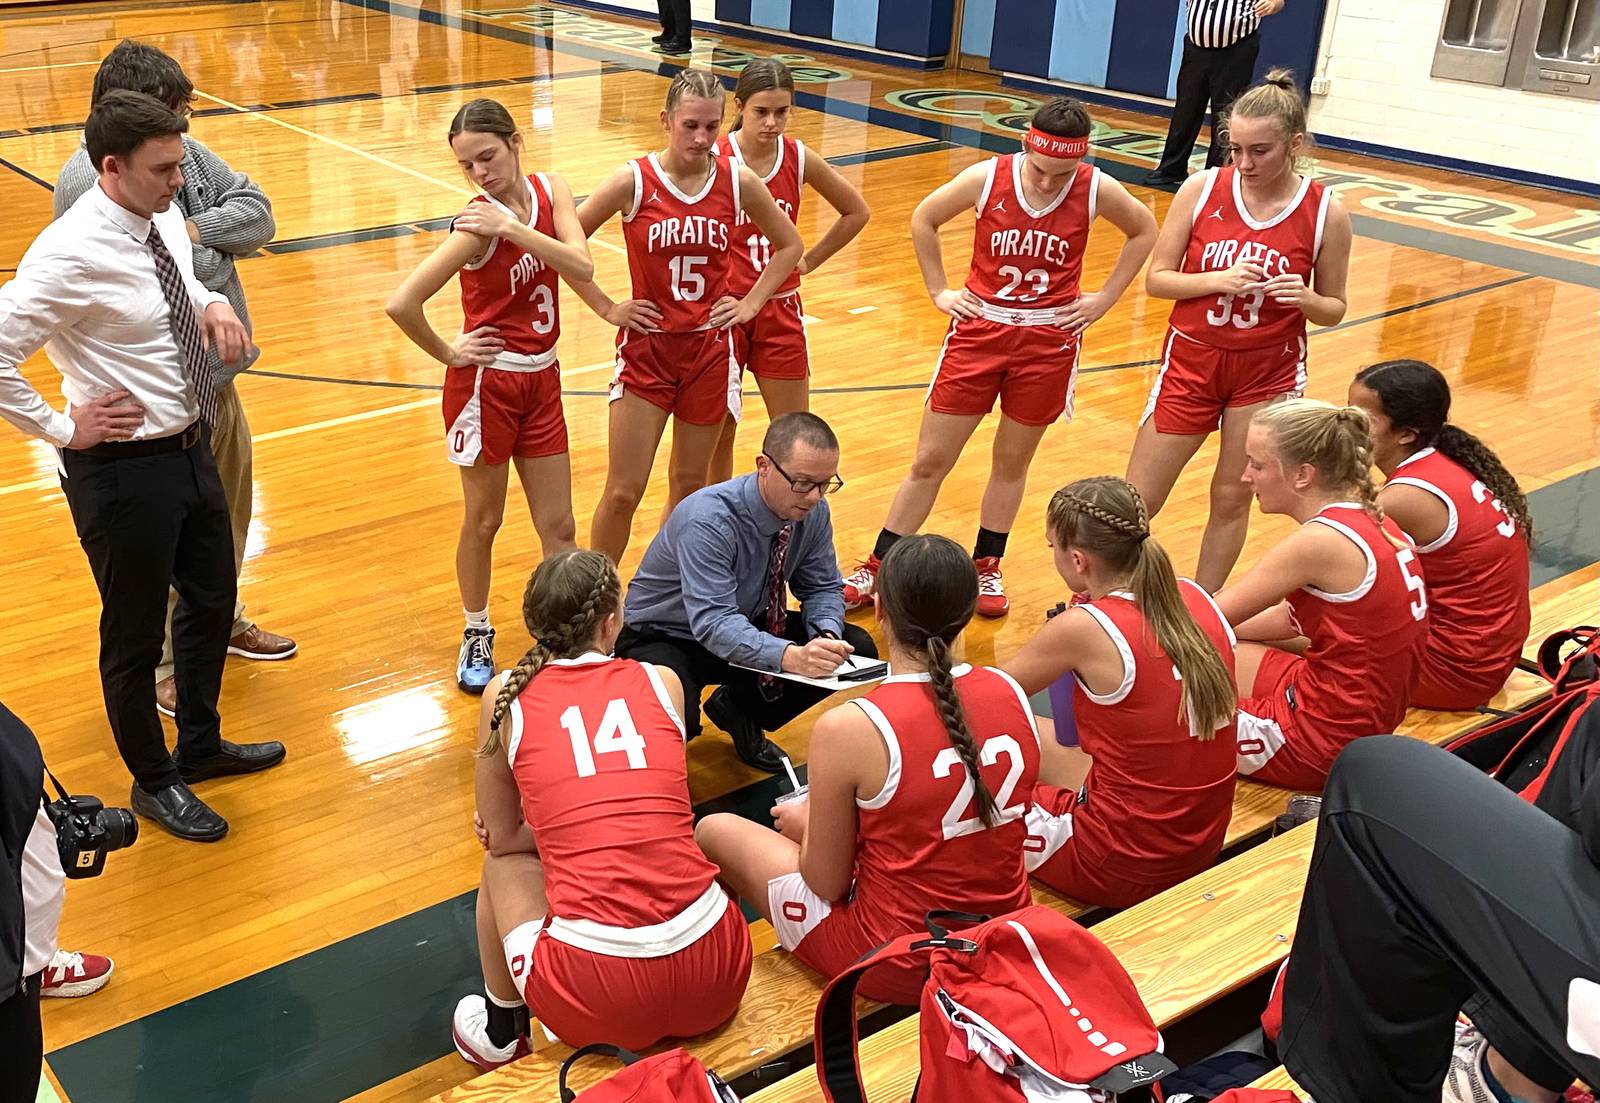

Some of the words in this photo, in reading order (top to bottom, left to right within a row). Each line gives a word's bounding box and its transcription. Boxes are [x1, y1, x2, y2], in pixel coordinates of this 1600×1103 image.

[648, 215, 728, 253] PIRATES
[991, 229, 1069, 266] PIRATES
[668, 256, 708, 301] 15
[1201, 240, 1290, 279] PIRATES
[993, 265, 1050, 302] 23
[529, 284, 555, 334] 3
[1207, 287, 1265, 329] 33
[1396, 548, 1428, 621] 5
[559, 698, 647, 778] 14
[932, 734, 1026, 841] 22
[82, 853, 90, 864] 5
